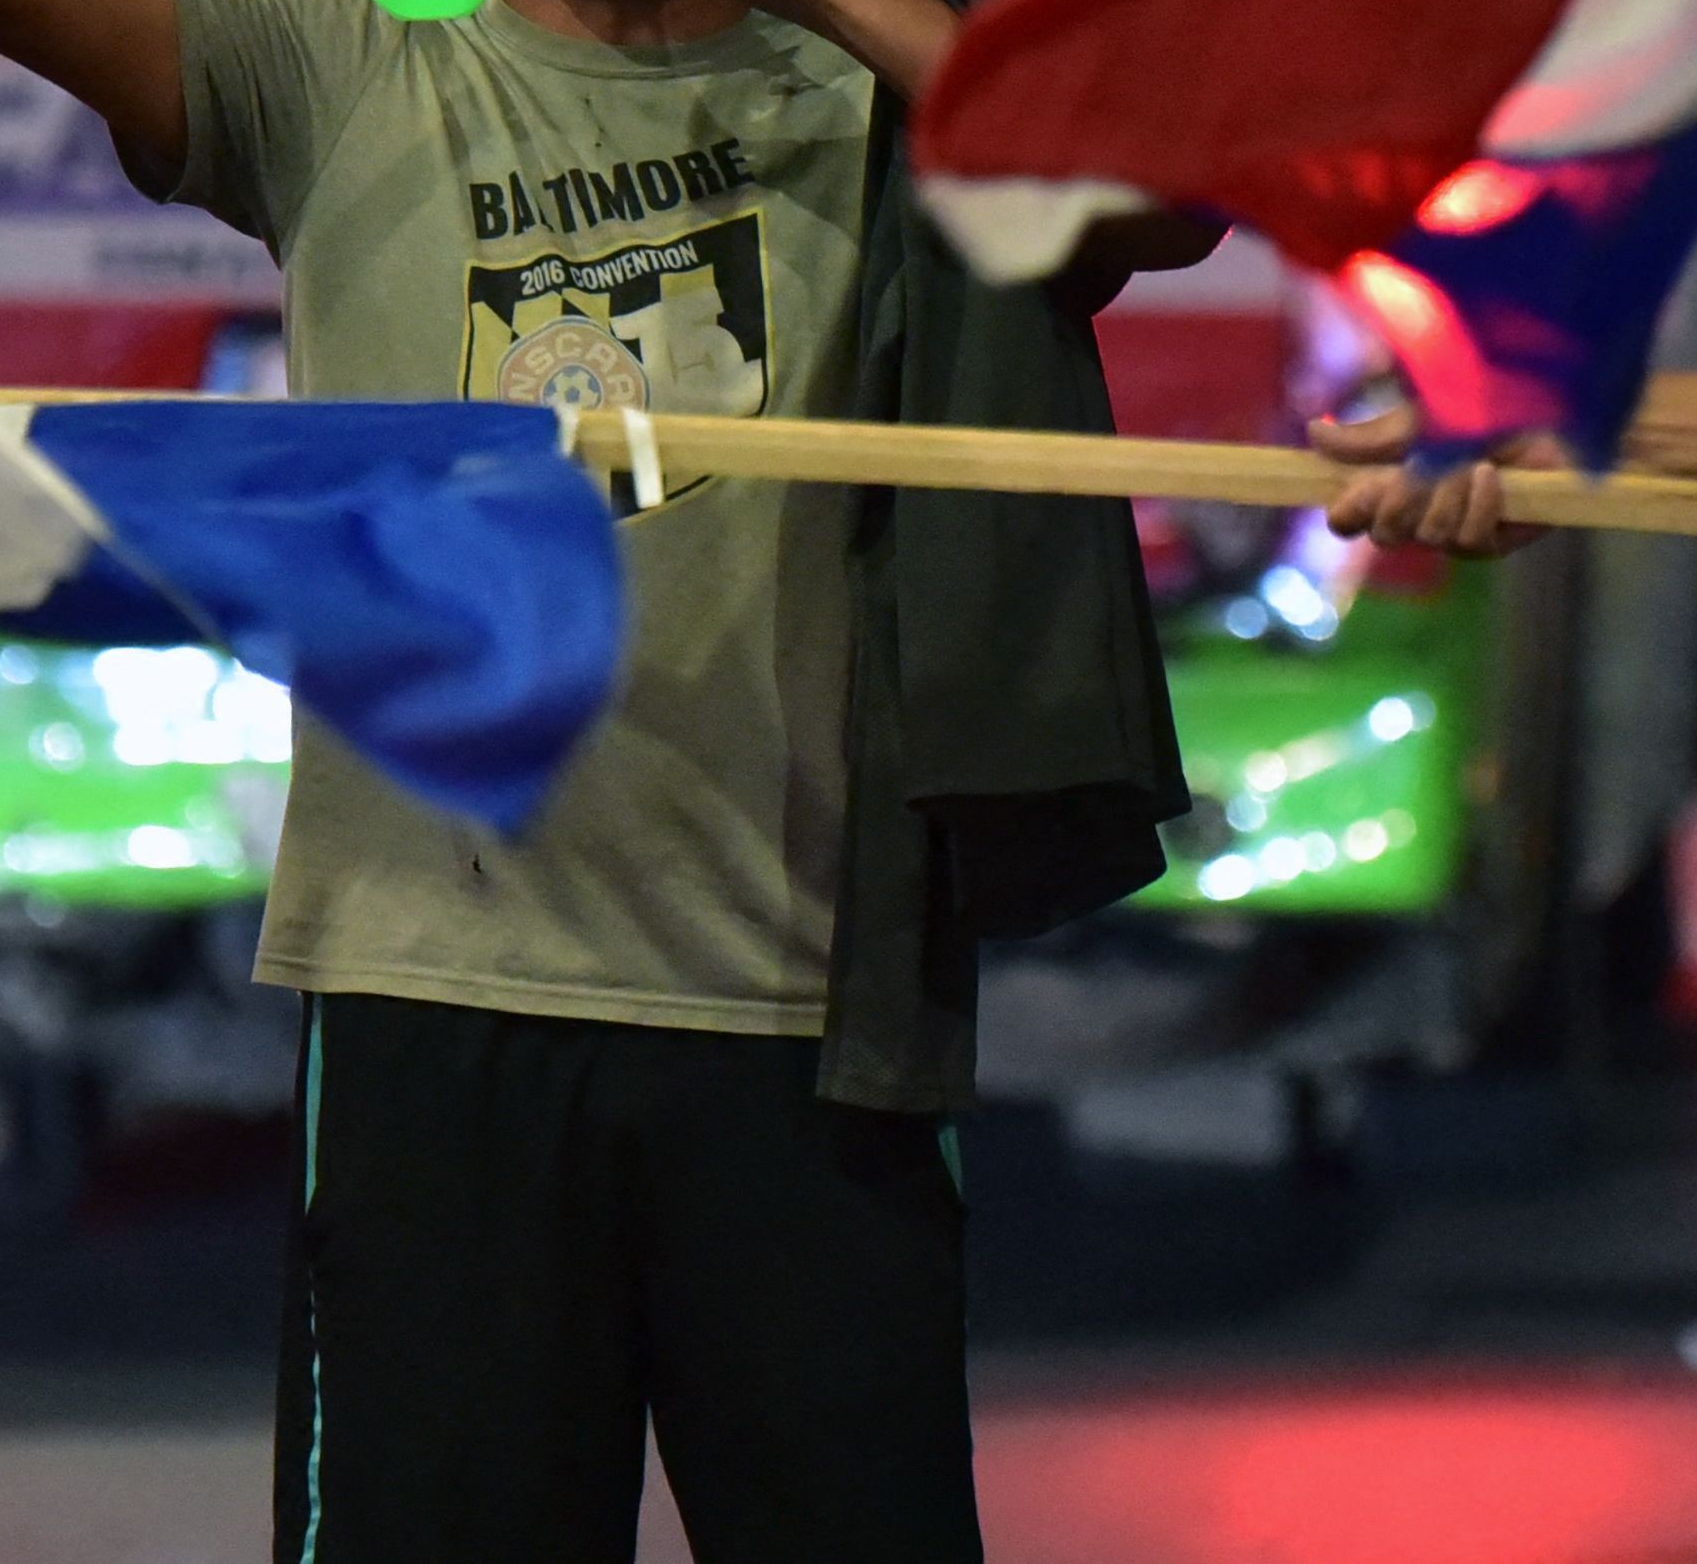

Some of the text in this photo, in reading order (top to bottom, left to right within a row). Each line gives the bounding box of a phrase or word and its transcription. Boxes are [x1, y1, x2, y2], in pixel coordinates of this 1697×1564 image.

[469, 138, 755, 240] BATIMORE
[520, 239, 700, 296] 2016 CONVENTION
